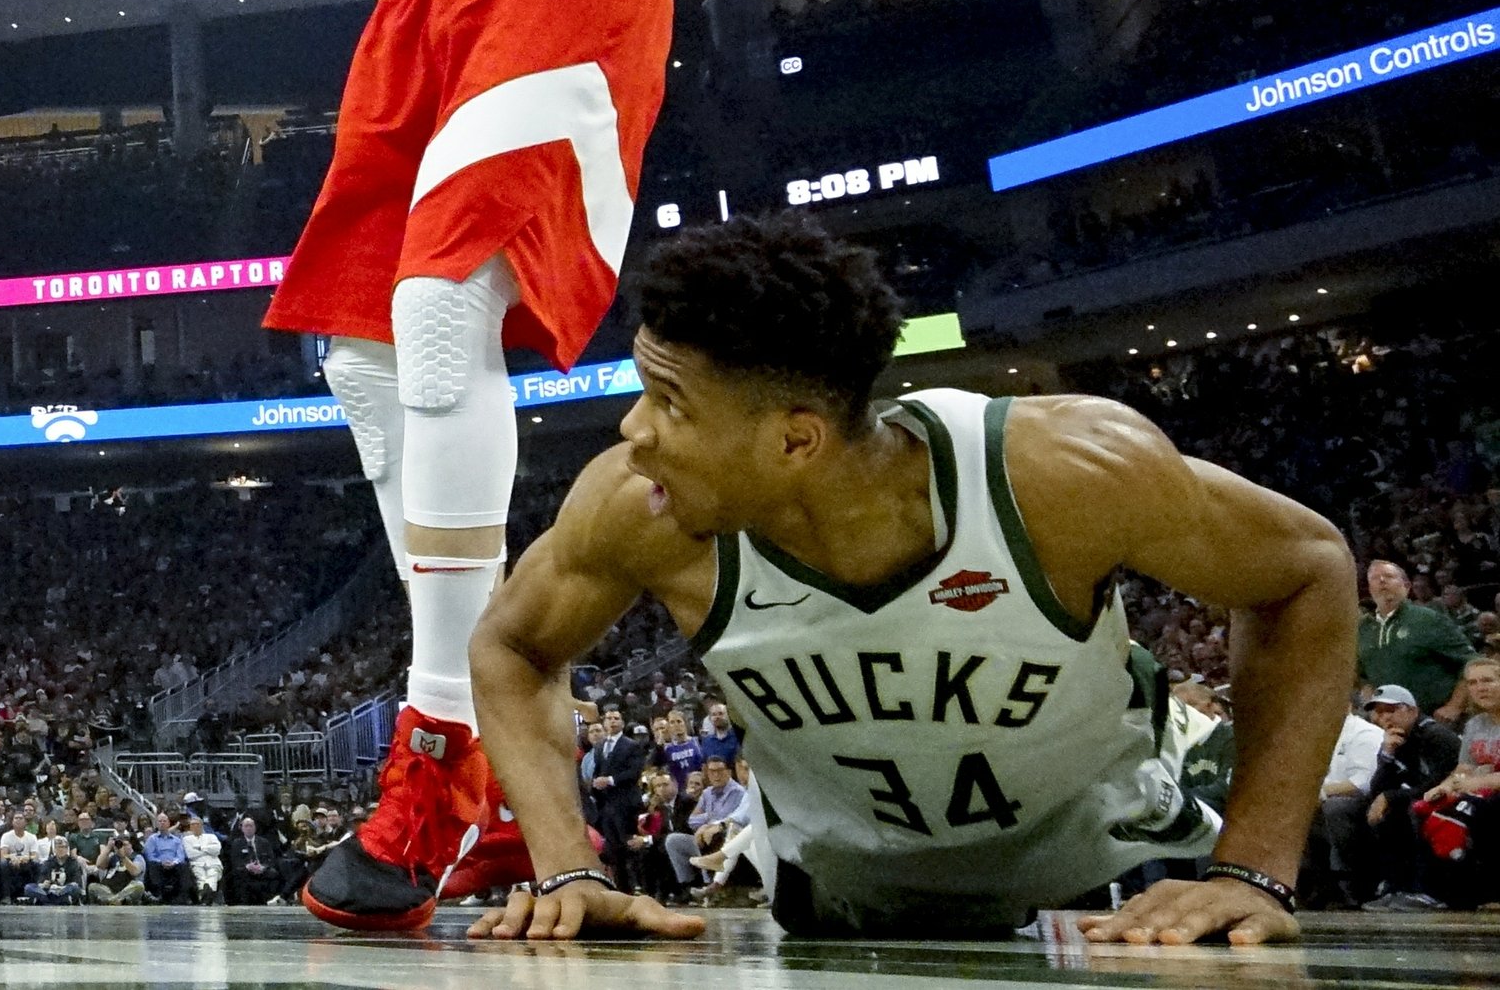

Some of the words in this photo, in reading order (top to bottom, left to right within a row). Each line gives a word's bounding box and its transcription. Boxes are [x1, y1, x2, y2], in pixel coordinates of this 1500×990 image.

[781, 58, 802, 73] CC
[1246, 61, 1363, 112] Johnson
[1369, 22, 1495, 76] Controls
[786, 169, 871, 205] 8:08
[878, 155, 940, 190] PM
[656, 203, 681, 228] 6
[33, 270, 161, 301] TORONTO
[171, 259, 285, 290] RAPTOR
[523, 374, 591, 400] Fiserv
[251, 403, 346, 426] Johnson
[727, 651, 1062, 731] BUCKS
[832, 752, 1021, 837] 34
